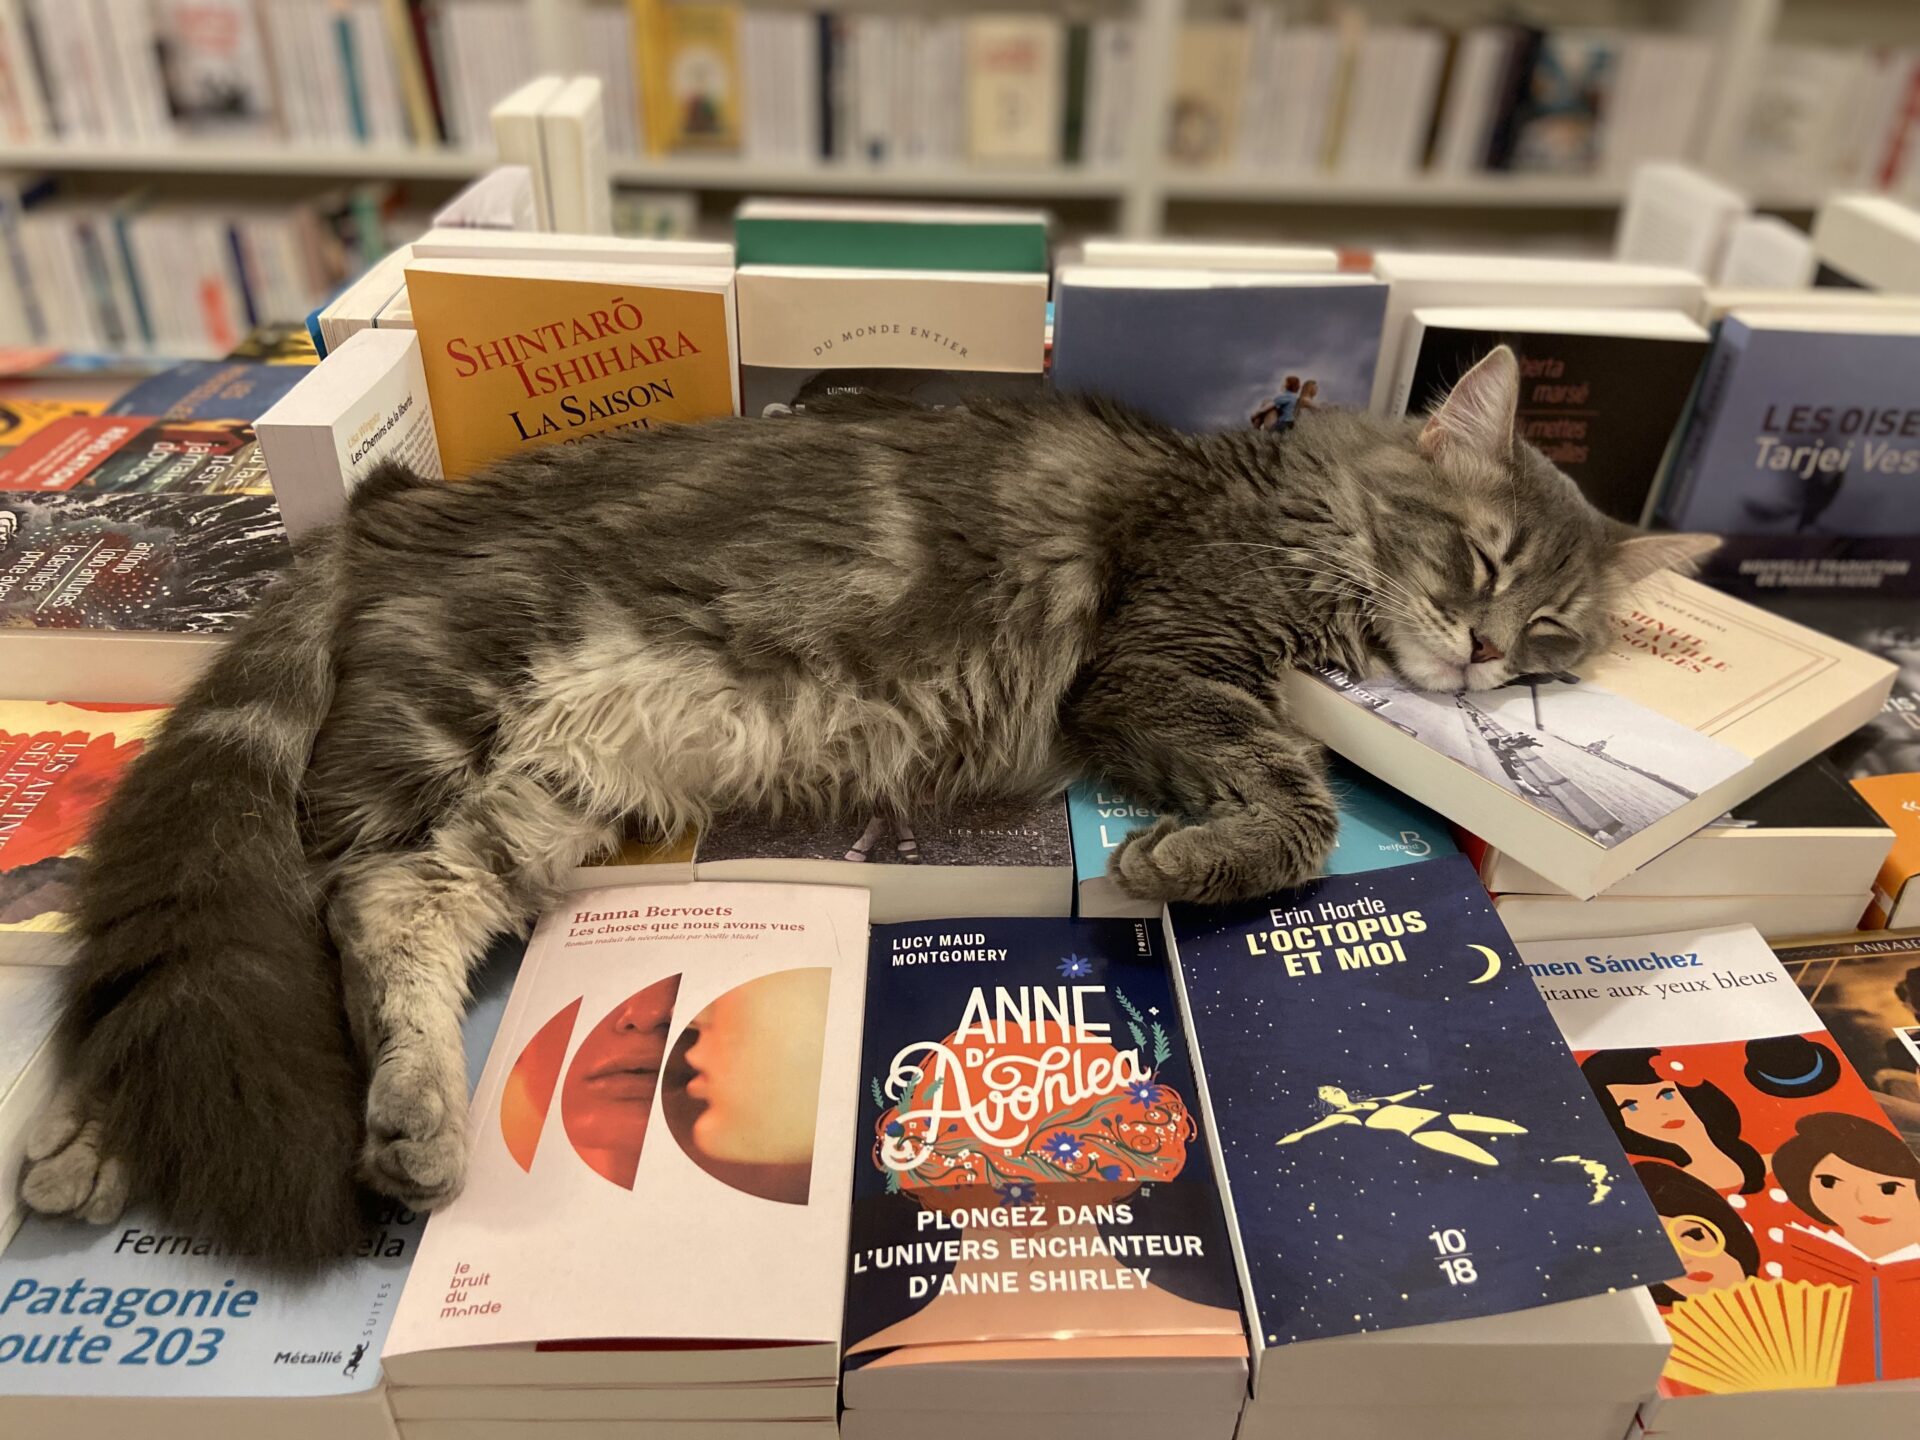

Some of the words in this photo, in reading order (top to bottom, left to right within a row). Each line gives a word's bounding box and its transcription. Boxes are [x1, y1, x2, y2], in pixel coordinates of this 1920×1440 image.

[814, 339, 833, 356] DU
[842, 324, 901, 342] MONDE
[910, 326, 968, 357] ENTIER
[513, 331, 701, 399] ISHIHARA
[509, 410, 561, 441] LA
[561, 379, 675, 428] SAISON
[1763, 405, 1834, 434] LES
[350, 449, 363, 465] Les
[362, 424, 388, 454] Chemins
[387, 415, 395, 431] de
[118, 441, 180, 483] douce
[153, 440, 221, 484] jamais
[1756, 437, 1851, 480] Tarjei
[1862, 441, 1920, 475] Ves
[225, 467, 268, 488] lac
[8, 551, 45, 575] porte
[59, 545, 88, 554] la
[88, 548, 126, 567] lobo
[113, 541, 155, 574] antónio
[22, 554, 75, 591] dernière
[52, 568, 100, 607] antunes
[0, 575, 20, 602] avan
[1631, 610, 1708, 646] MINUIT
[1621, 633, 1706, 674] SONGES
[1669, 640, 1733, 672] VILLE
[55, 742, 88, 774] LES
[1097, 792, 1126, 805] La
[1378, 843, 1419, 852] belfond
[573, 909, 639, 924] Hanna
[645, 905, 733, 918] Bervoets
[1269, 907, 1314, 928] Erin
[1318, 897, 1387, 922] Hortle
[568, 927, 594, 938] Les
[597, 922, 647, 935] choses
[650, 922, 678, 934] que
[683, 920, 720, 931] nous
[723, 921, 767, 931] avons
[770, 921, 806, 932] vues
[893, 935, 933, 951] LUCY
[939, 933, 986, 947] MAUD
[1133, 922, 1147, 953] POINTS
[1245, 910, 1428, 956] L'OCTOPUS
[892, 949, 1008, 967] MONTGOMERY
[1283, 951, 1323, 977] ET
[1335, 940, 1407, 971] MOI
[1854, 939, 1920, 954] ANNABE
[1526, 961, 1583, 976] men
[1584, 950, 1703, 974] Sánchez
[1541, 984, 1601, 1001] itane
[1606, 984, 1650, 999] aux
[1653, 980, 1712, 1000] yeux
[1711, 968, 1779, 990] bleus
[953, 985, 1112, 1045] ANNE
[880, 1041, 1152, 1172] Avonlea
[917, 1206, 1048, 1232] PLONGEZ
[1057, 1204, 1134, 1226] DANS
[853, 1239, 1000, 1274] L'UNIVERS
[1010, 1235, 1205, 1259] ENCHANTEUR
[1428, 1229, 1467, 1255] 10
[450, 1273, 491, 1289] bruit
[454, 1262, 471, 1275] le
[909, 1271, 1020, 1298] D'ANNE
[1028, 1268, 1151, 1292] SHIRLEY
[1439, 1257, 1478, 1285] 18
[0, 1278, 260, 1328] Patagonie
[362, 1282, 392, 1337] SUITES
[445, 1290, 468, 1304] du
[118, 1326, 225, 1367] 203
[273, 1351, 343, 1365] Métailié
